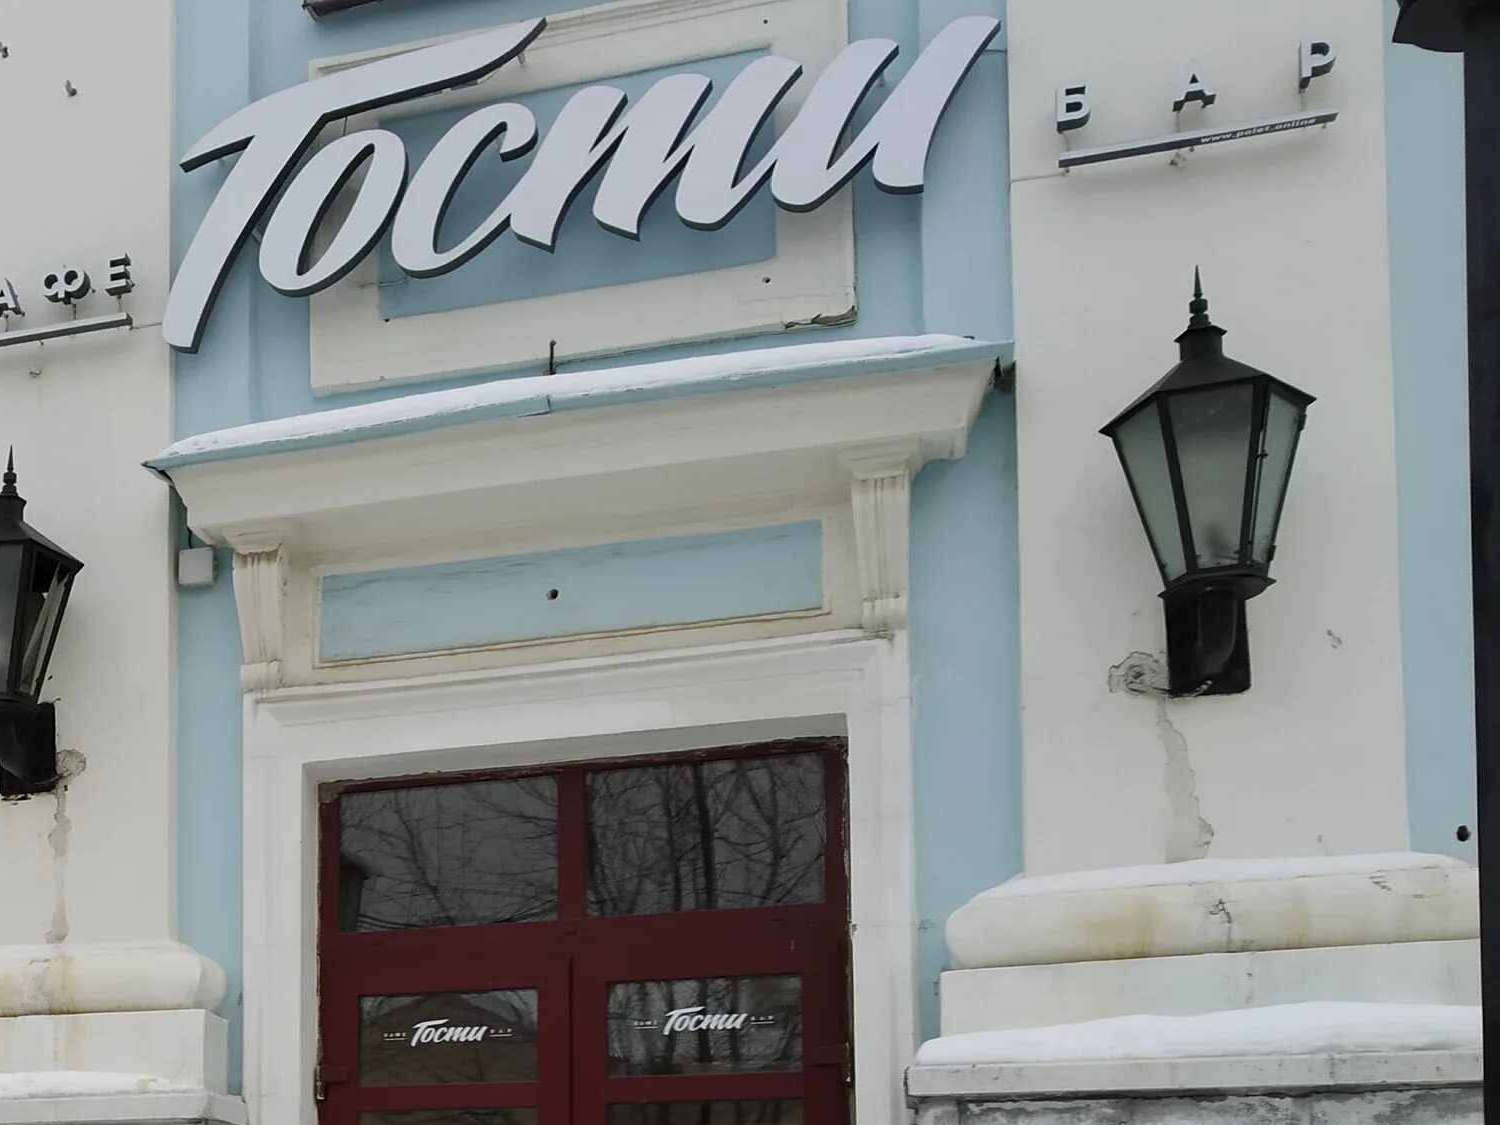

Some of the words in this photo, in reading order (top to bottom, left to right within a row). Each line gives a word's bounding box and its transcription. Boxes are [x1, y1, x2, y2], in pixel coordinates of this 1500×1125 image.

[162, 16, 1002, 354] Гости
[1055, 41, 1338, 133] БАР
[410, 1018, 489, 1047] Гости
[662, 1005, 748, 1036] Гости
